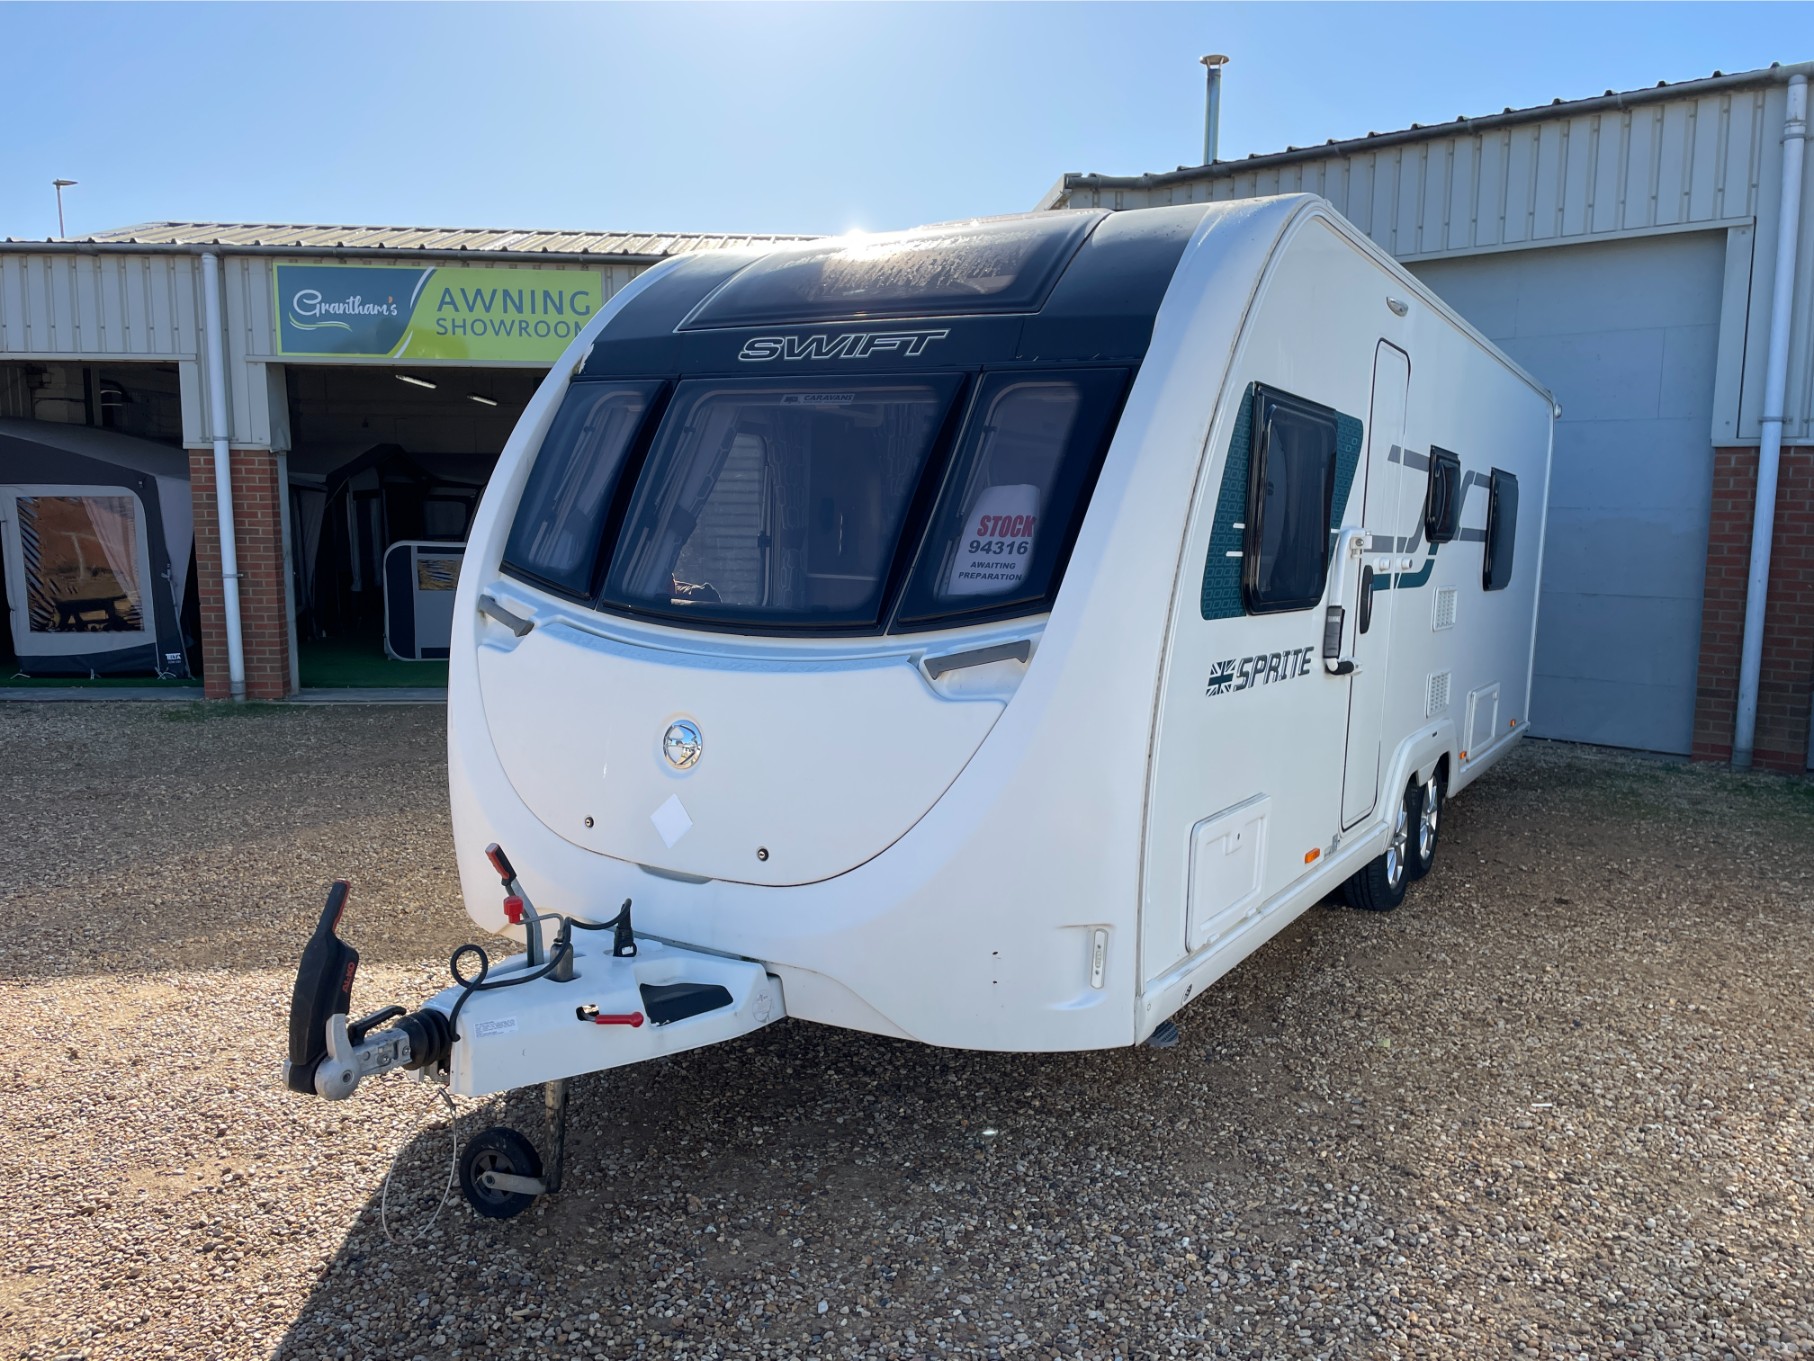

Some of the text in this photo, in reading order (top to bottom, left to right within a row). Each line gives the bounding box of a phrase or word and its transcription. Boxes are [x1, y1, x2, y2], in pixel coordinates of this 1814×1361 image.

[293, 289, 398, 317] Grantham's
[436, 287, 591, 316] AWNING
[738, 328, 950, 361] SWIFT
[977, 515, 1035, 538] STOCK
[968, 540, 1029, 555] 94316
[958, 572, 1022, 581] PREPARATION
[970, 561, 1016, 569] AWAITING
[1233, 646, 1315, 692] SPRITE
